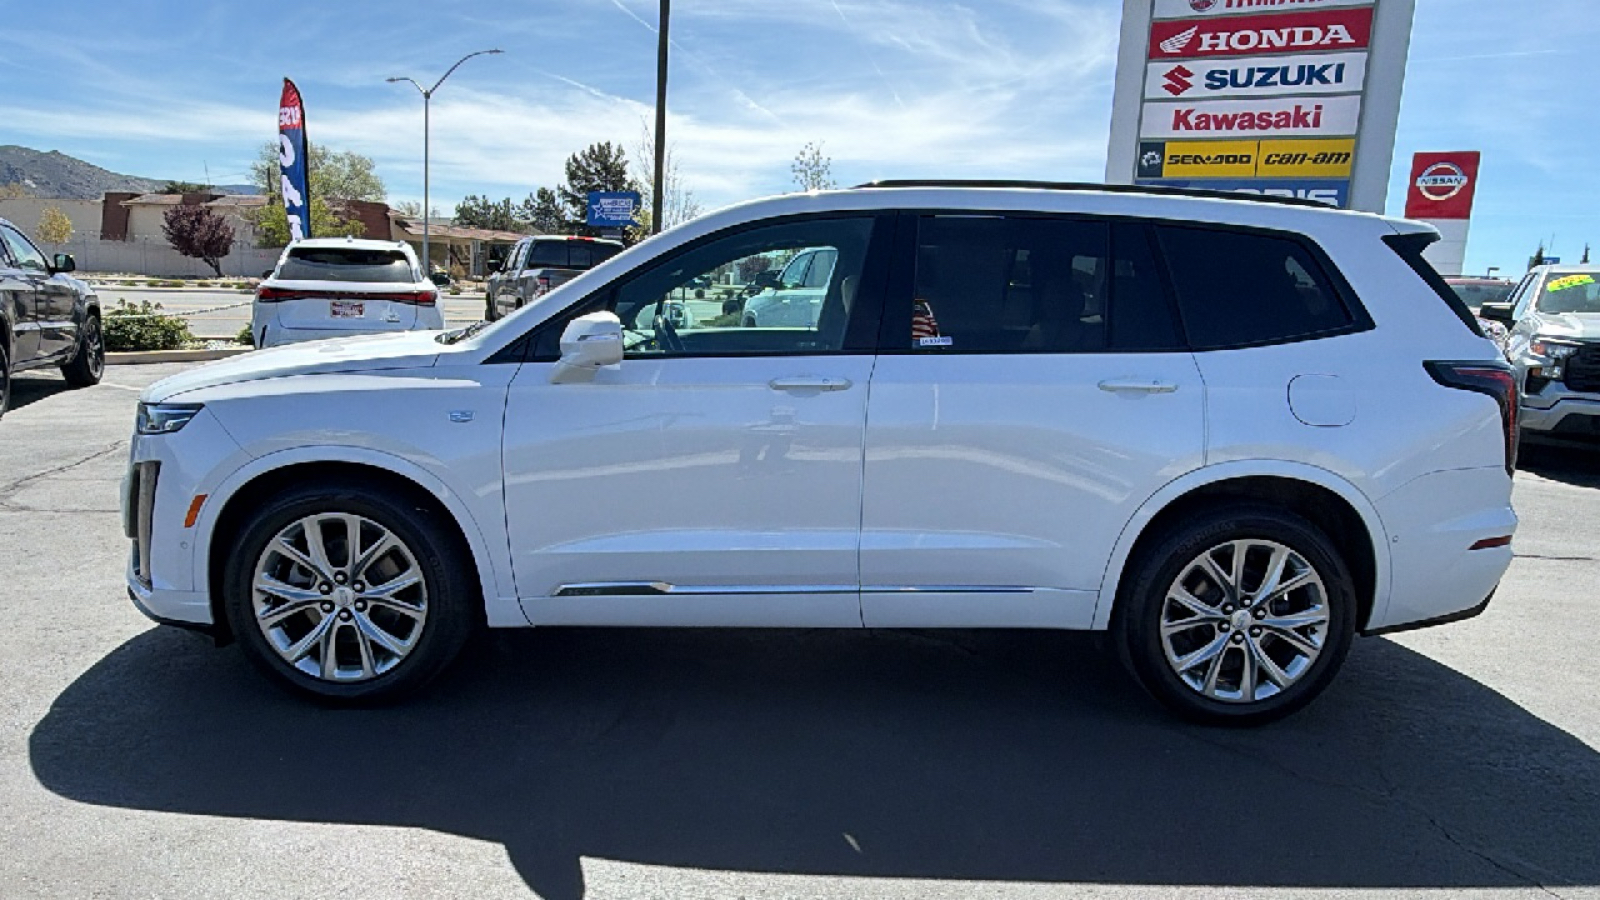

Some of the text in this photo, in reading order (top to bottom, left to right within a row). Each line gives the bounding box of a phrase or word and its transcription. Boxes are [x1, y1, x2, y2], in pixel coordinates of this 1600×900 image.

[1197, 24, 1355, 51] HONDA
[1204, 63, 1346, 90] SUZUKI
[1172, 105, 1323, 131] Kawasaki
[1420, 177, 1463, 185] NISSAN
